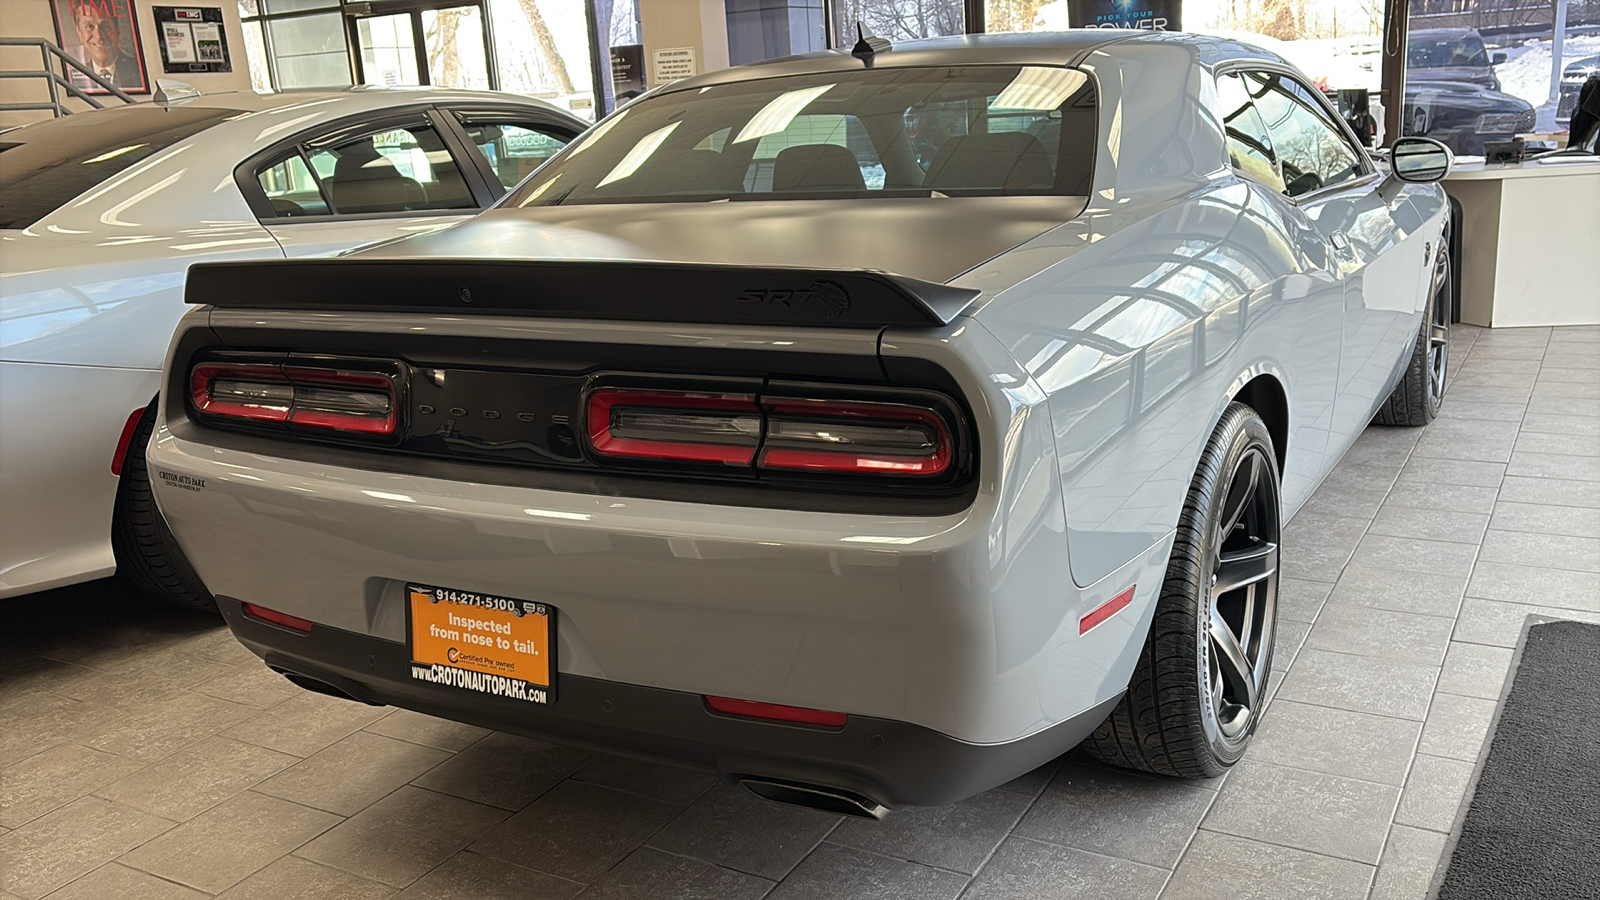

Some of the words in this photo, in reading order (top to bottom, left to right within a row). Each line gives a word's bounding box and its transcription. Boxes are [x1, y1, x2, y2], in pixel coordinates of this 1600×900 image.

[68, 0, 127, 18] TIME
[1126, 10, 1154, 18] YOUR
[1085, 18, 1168, 31] WER
[737, 289, 820, 307] SRT
[418, 404, 570, 424] DODGE
[159, 470, 178, 481] CROTON
[178, 475, 192, 485] AUTO
[192, 479, 206, 488] PARK
[448, 612, 511, 635] Inspected
[429, 624, 459, 641] from
[463, 632, 493, 648] nose
[496, 636, 510, 650] to
[513, 640, 539, 655] tail.
[459, 652, 483, 664] Certified
